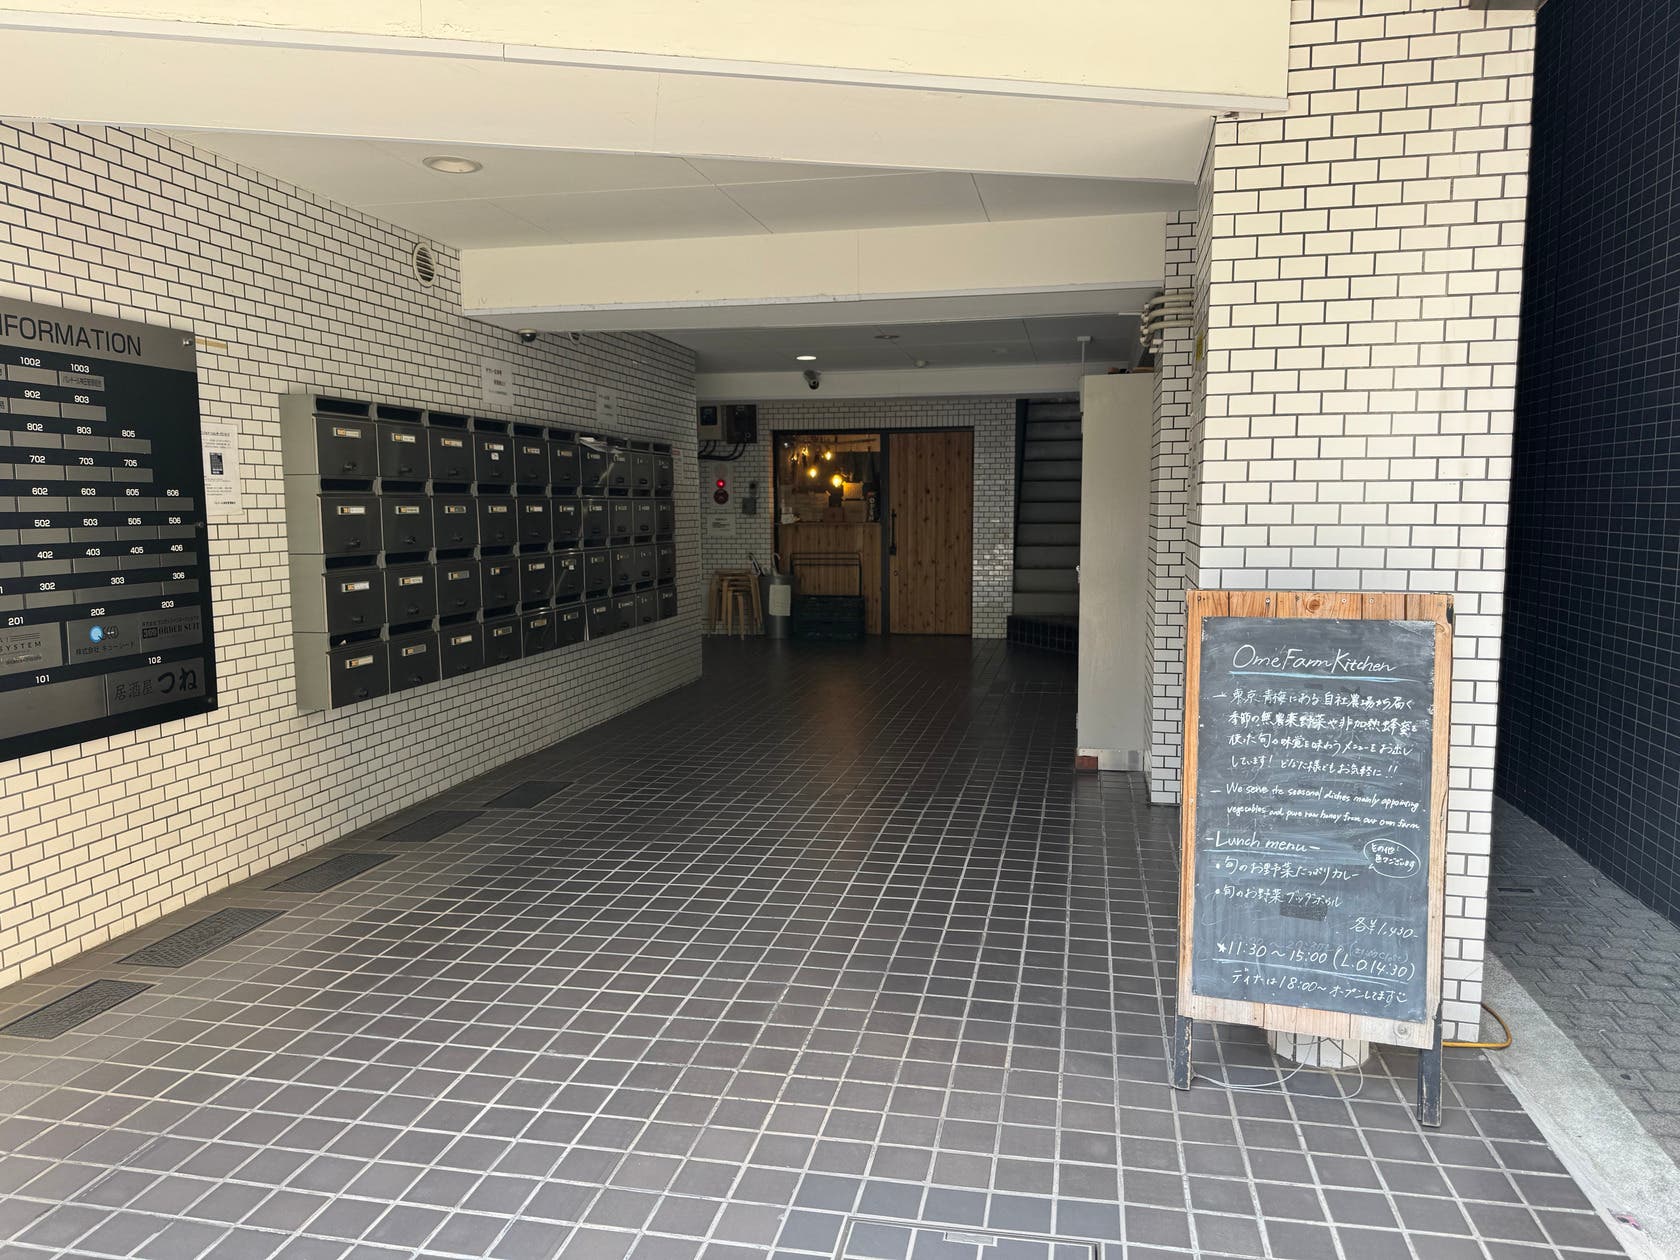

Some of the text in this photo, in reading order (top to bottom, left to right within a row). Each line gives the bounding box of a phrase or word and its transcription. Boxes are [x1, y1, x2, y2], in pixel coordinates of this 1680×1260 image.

[0, 313, 142, 357] FORMATION
[20, 356, 41, 367] 1002
[70, 363, 90, 374] 1003
[24, 389, 41, 399] 902
[74, 394, 90, 404] 903
[26, 422, 43, 432] 802
[76, 426, 92, 435] 803
[121, 429, 136, 438] 805
[29, 454, 46, 464] 702
[78, 457, 94, 465] 703
[123, 459, 138, 467] 705
[31, 487, 48, 496] 602
[80, 487, 96, 496] 603
[125, 488, 140, 496] 605
[166, 489, 179, 497] 606
[34, 519, 51, 528] 502
[83, 518, 98, 527] 503
[127, 517, 142, 525] 505
[168, 516, 182, 525] 506
[85, 548, 101, 556] 403
[130, 546, 144, 554] 405
[170, 544, 183, 552] 406
[37, 550, 53, 559] 402
[172, 571, 185, 580] 306
[110, 576, 125, 585] 303
[39, 582, 56, 591] 302
[161, 600, 174, 609] 203
[90, 607, 105, 617] 202
[8, 616, 24, 626] 201
[148, 655, 162, 665] 102
[35, 674, 50, 684] 101
[158, 667, 197, 694] つね
[1226, 781, 1243, 795] We
[1287, 786, 1323, 800] seasonal
[1353, 793, 1380, 808] mainly
[1268, 807, 1284, 816] and
[1319, 809, 1342, 823] honey
[1363, 817, 1378, 825] our
[1379, 819, 1396, 827] own
